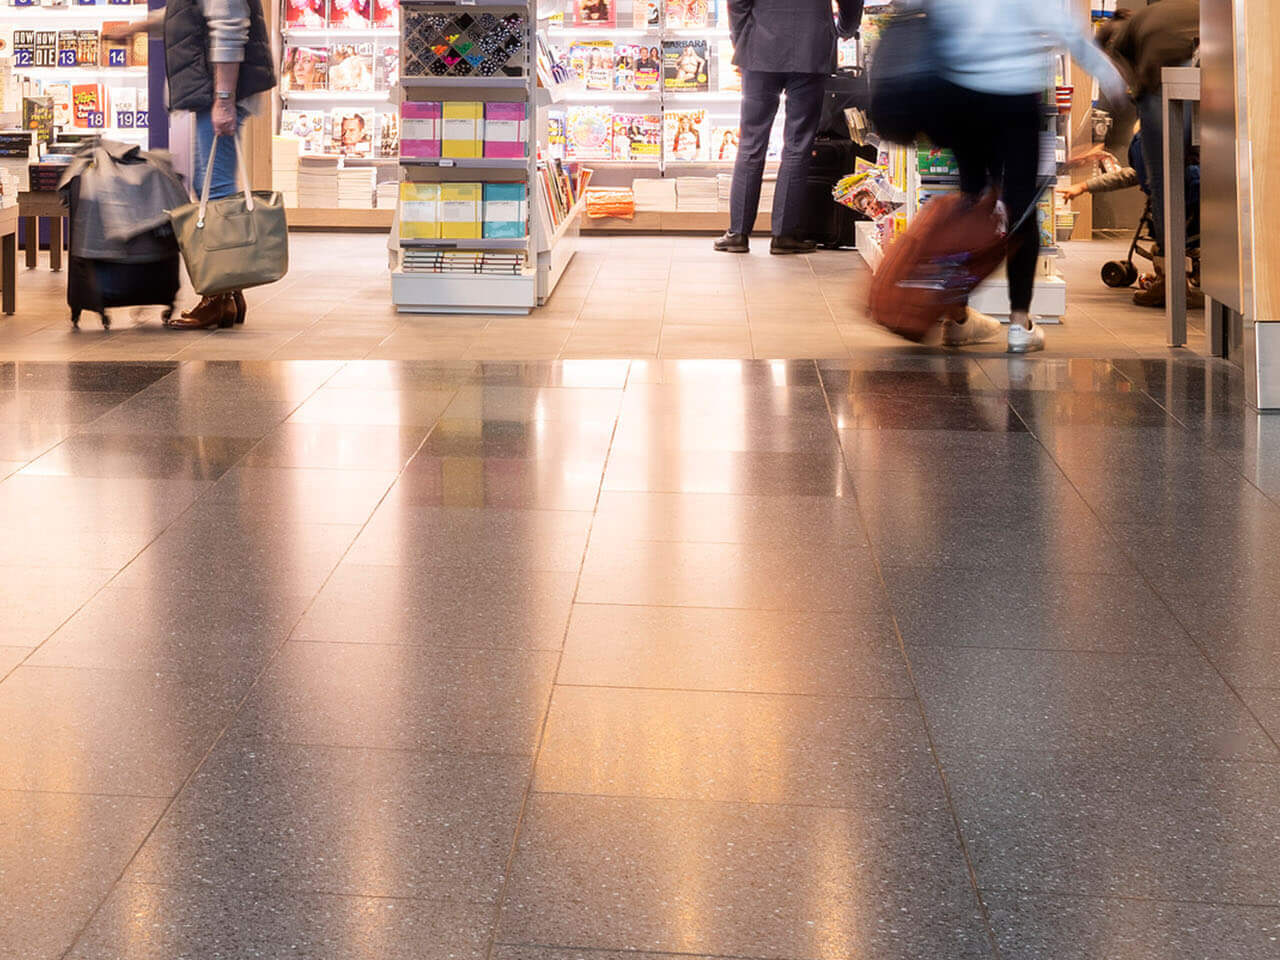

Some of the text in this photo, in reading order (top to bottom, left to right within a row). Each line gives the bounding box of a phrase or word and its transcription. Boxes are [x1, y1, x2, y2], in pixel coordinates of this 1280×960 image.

[14, 31, 35, 44] HOW
[36, 32, 56, 44] HOW
[15, 52, 30, 65] 12
[36, 49, 56, 66] DIE
[60, 52, 75, 64] 13
[110, 52, 125, 64] 14
[89, 113, 103, 126] 18
[118, 113, 133, 125] 19
[136, 113, 149, 125] 20
